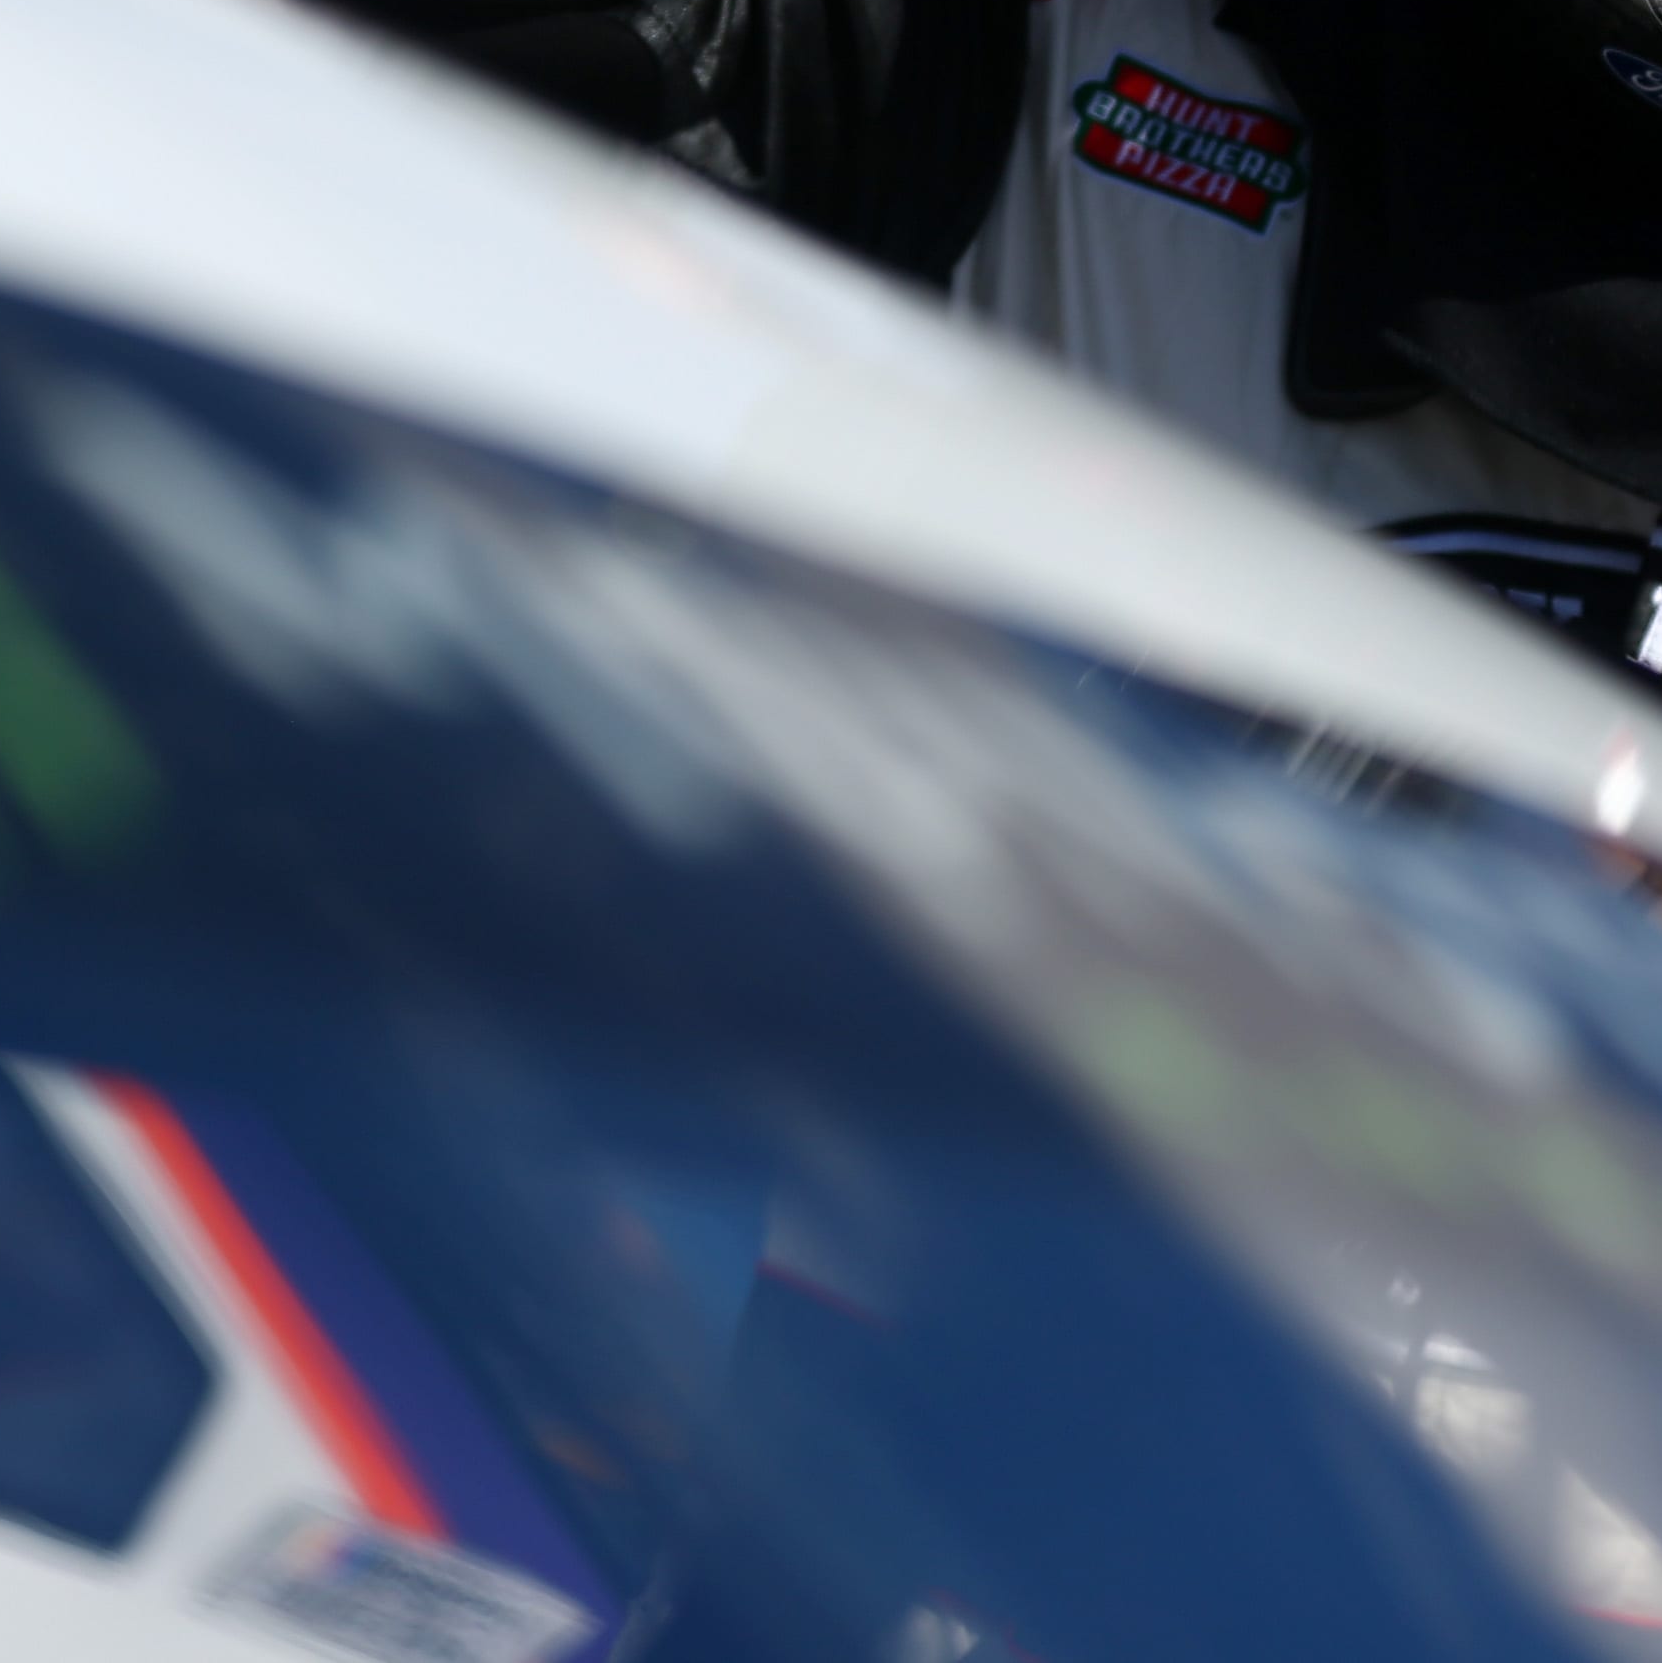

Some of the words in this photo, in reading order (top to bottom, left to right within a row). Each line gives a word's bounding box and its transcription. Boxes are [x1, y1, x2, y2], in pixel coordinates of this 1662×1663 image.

[1085, 90, 1296, 195] BROTHERS
[1144, 81, 1262, 144] HUNT
[1113, 139, 1240, 204] PIZZA
